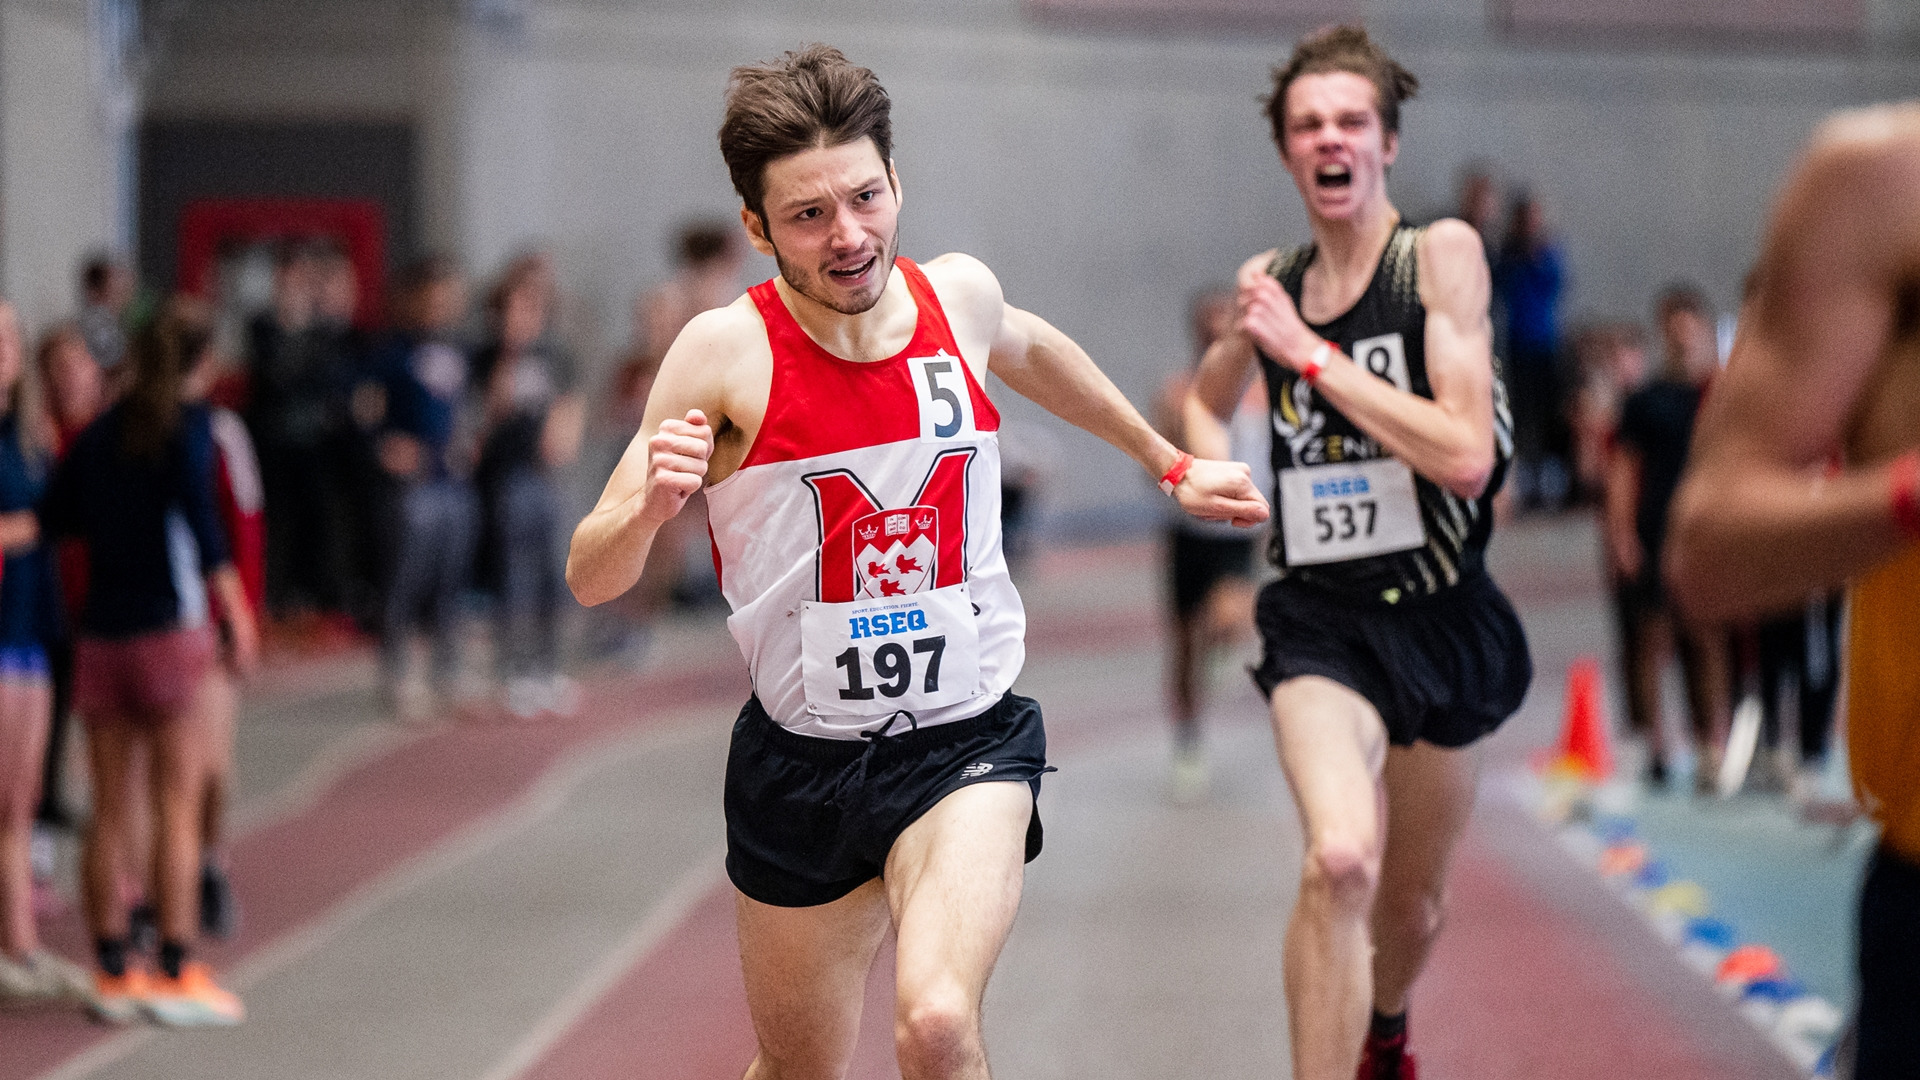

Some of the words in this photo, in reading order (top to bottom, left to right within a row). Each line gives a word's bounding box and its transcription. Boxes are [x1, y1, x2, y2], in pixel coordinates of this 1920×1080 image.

[923, 361, 962, 438] 5
[1314, 500, 1378, 543] 537
[849, 609, 928, 640] RSEQ
[835, 635, 946, 701] 197
